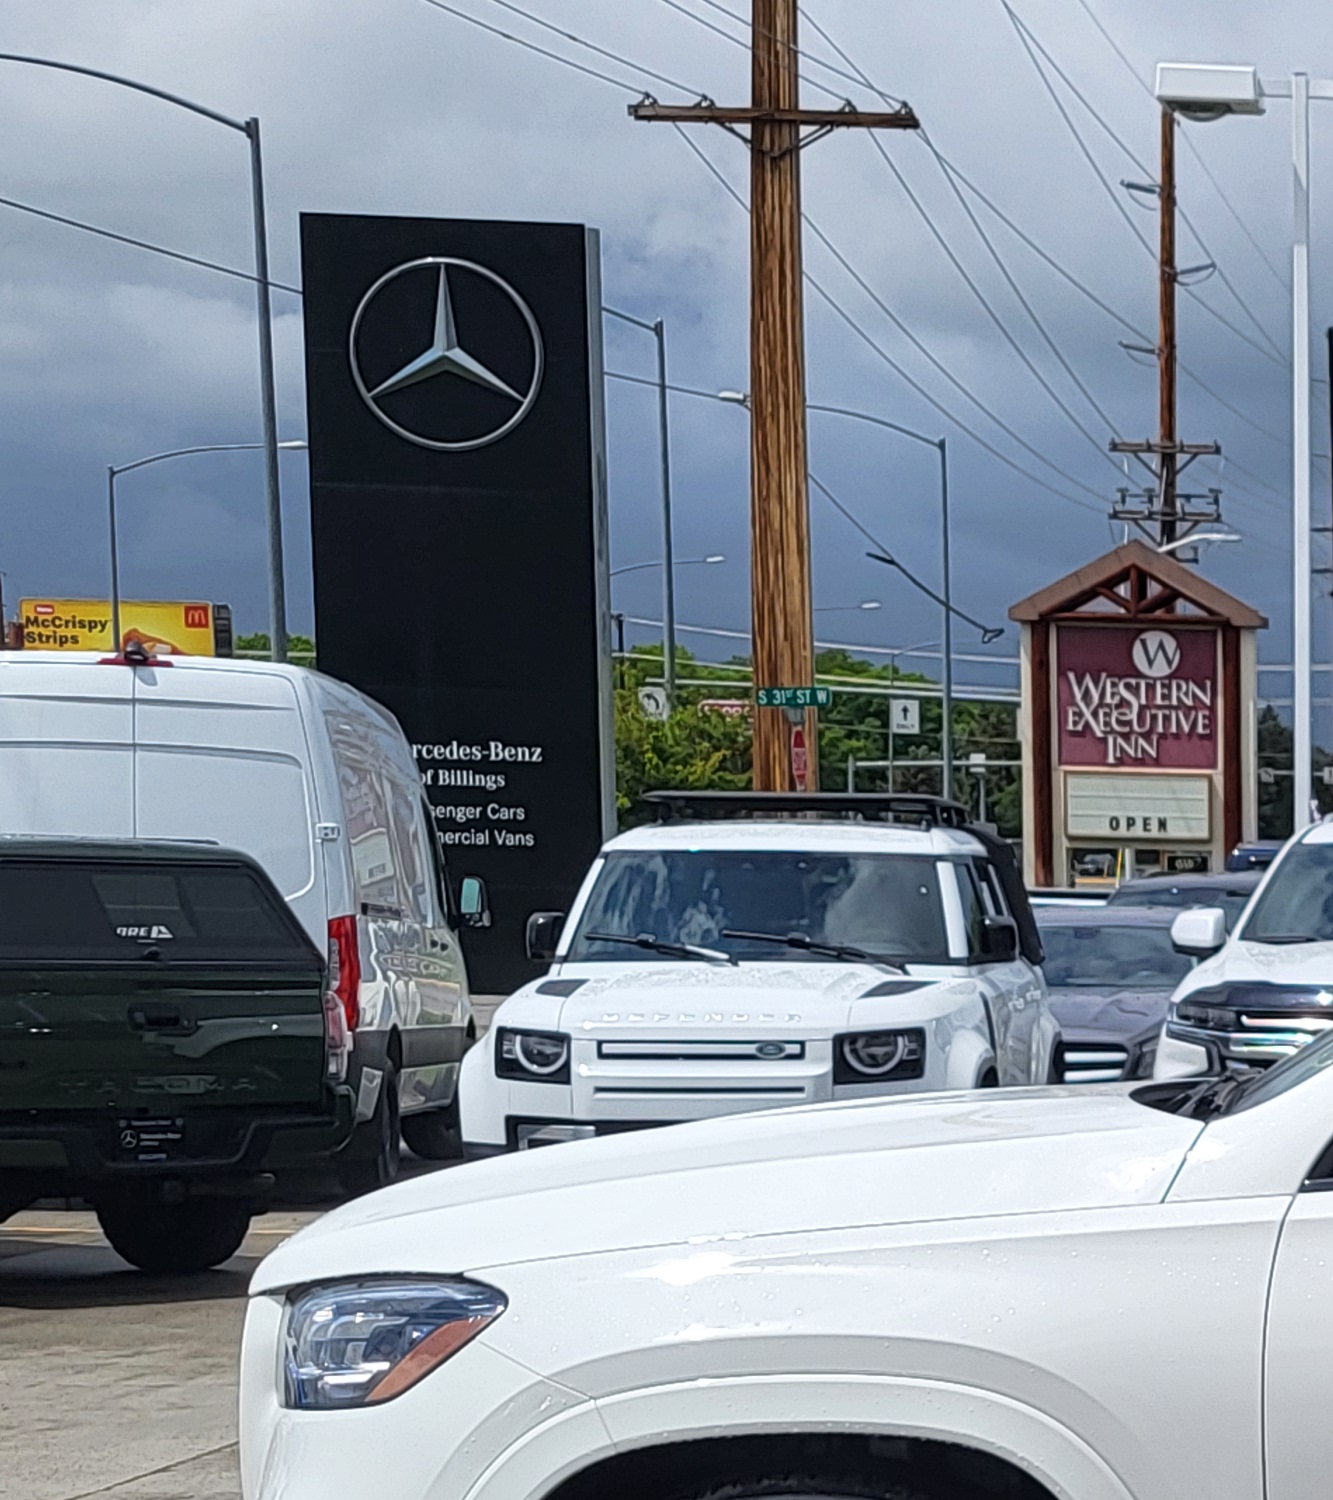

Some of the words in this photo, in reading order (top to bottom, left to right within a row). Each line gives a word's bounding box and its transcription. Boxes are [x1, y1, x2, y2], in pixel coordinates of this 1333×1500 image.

[25, 615, 108, 632] McCrispy
[26, 631, 79, 646] Strips
[1139, 638, 1179, 670] W
[758, 690, 767, 704] S
[796, 690, 811, 704] ST
[816, 690, 827, 704] W
[1066, 671, 1211, 706] WESTERN
[1066, 703, 1210, 737] EXECUTIVE
[411, 740, 543, 762] rcedes-Benz
[1106, 733, 1158, 764] INN
[438, 769, 506, 790] Billings
[487, 803, 525, 820] Cars
[1109, 816, 1168, 833] OPEN
[494, 829, 535, 846] Vans
